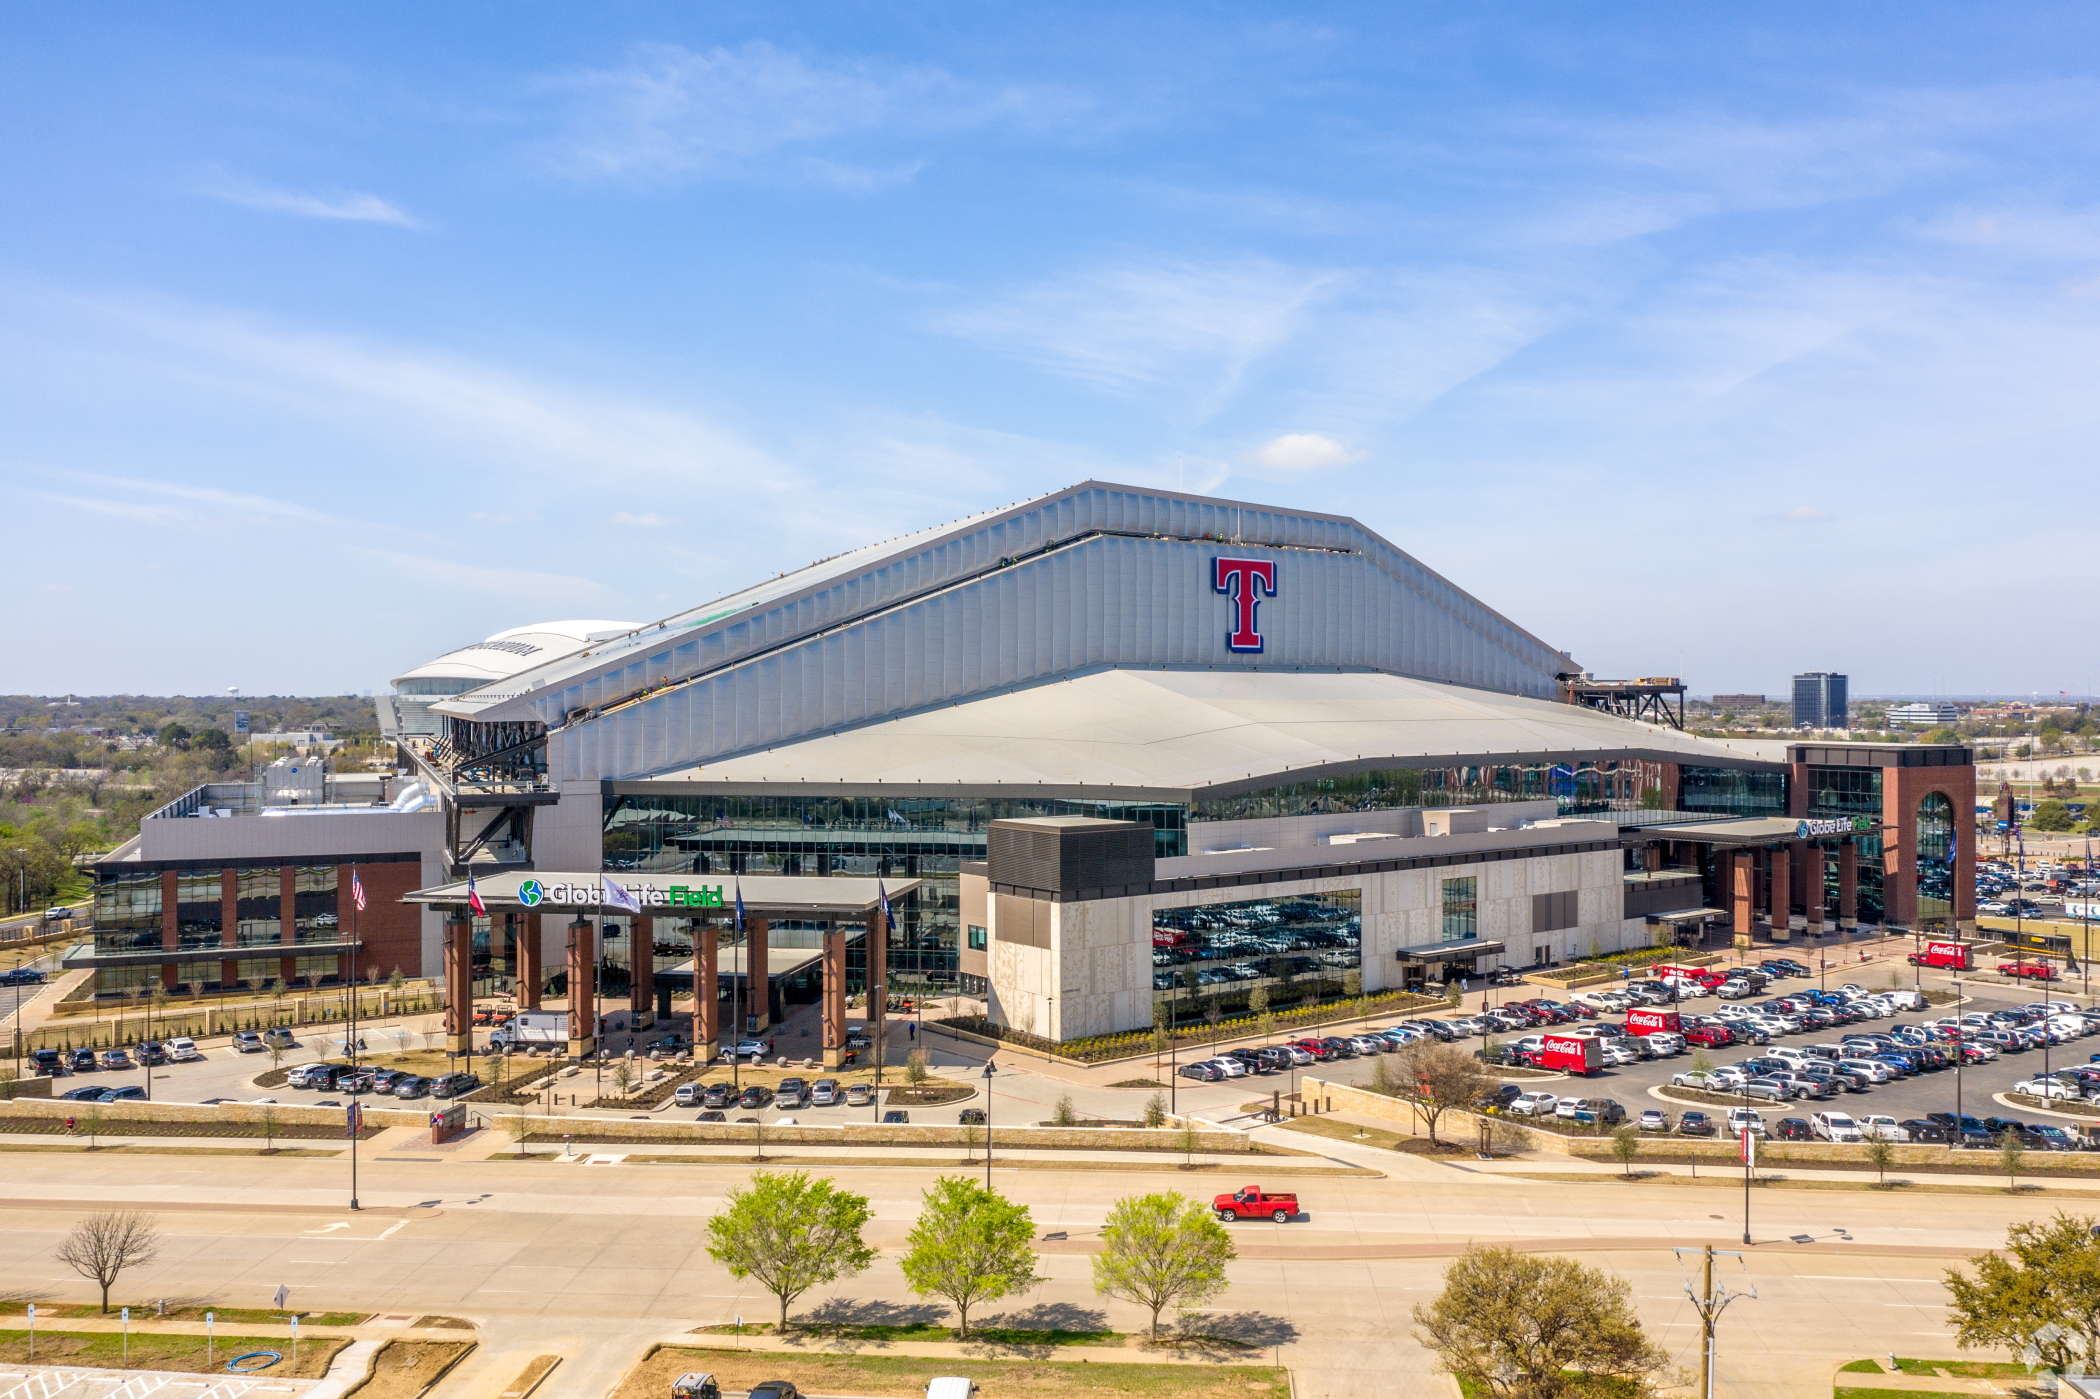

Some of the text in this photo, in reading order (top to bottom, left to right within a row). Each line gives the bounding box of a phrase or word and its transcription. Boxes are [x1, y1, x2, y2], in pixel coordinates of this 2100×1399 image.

[1214, 557, 1277, 653] T
[1810, 815, 1871, 835] Globe Life Field
[549, 883, 606, 905] Glob
[669, 884, 723, 907] Field
[1629, 1013, 1659, 1027] Coca-Cola
[1546, 1039, 1577, 1054] Coca-Cola
